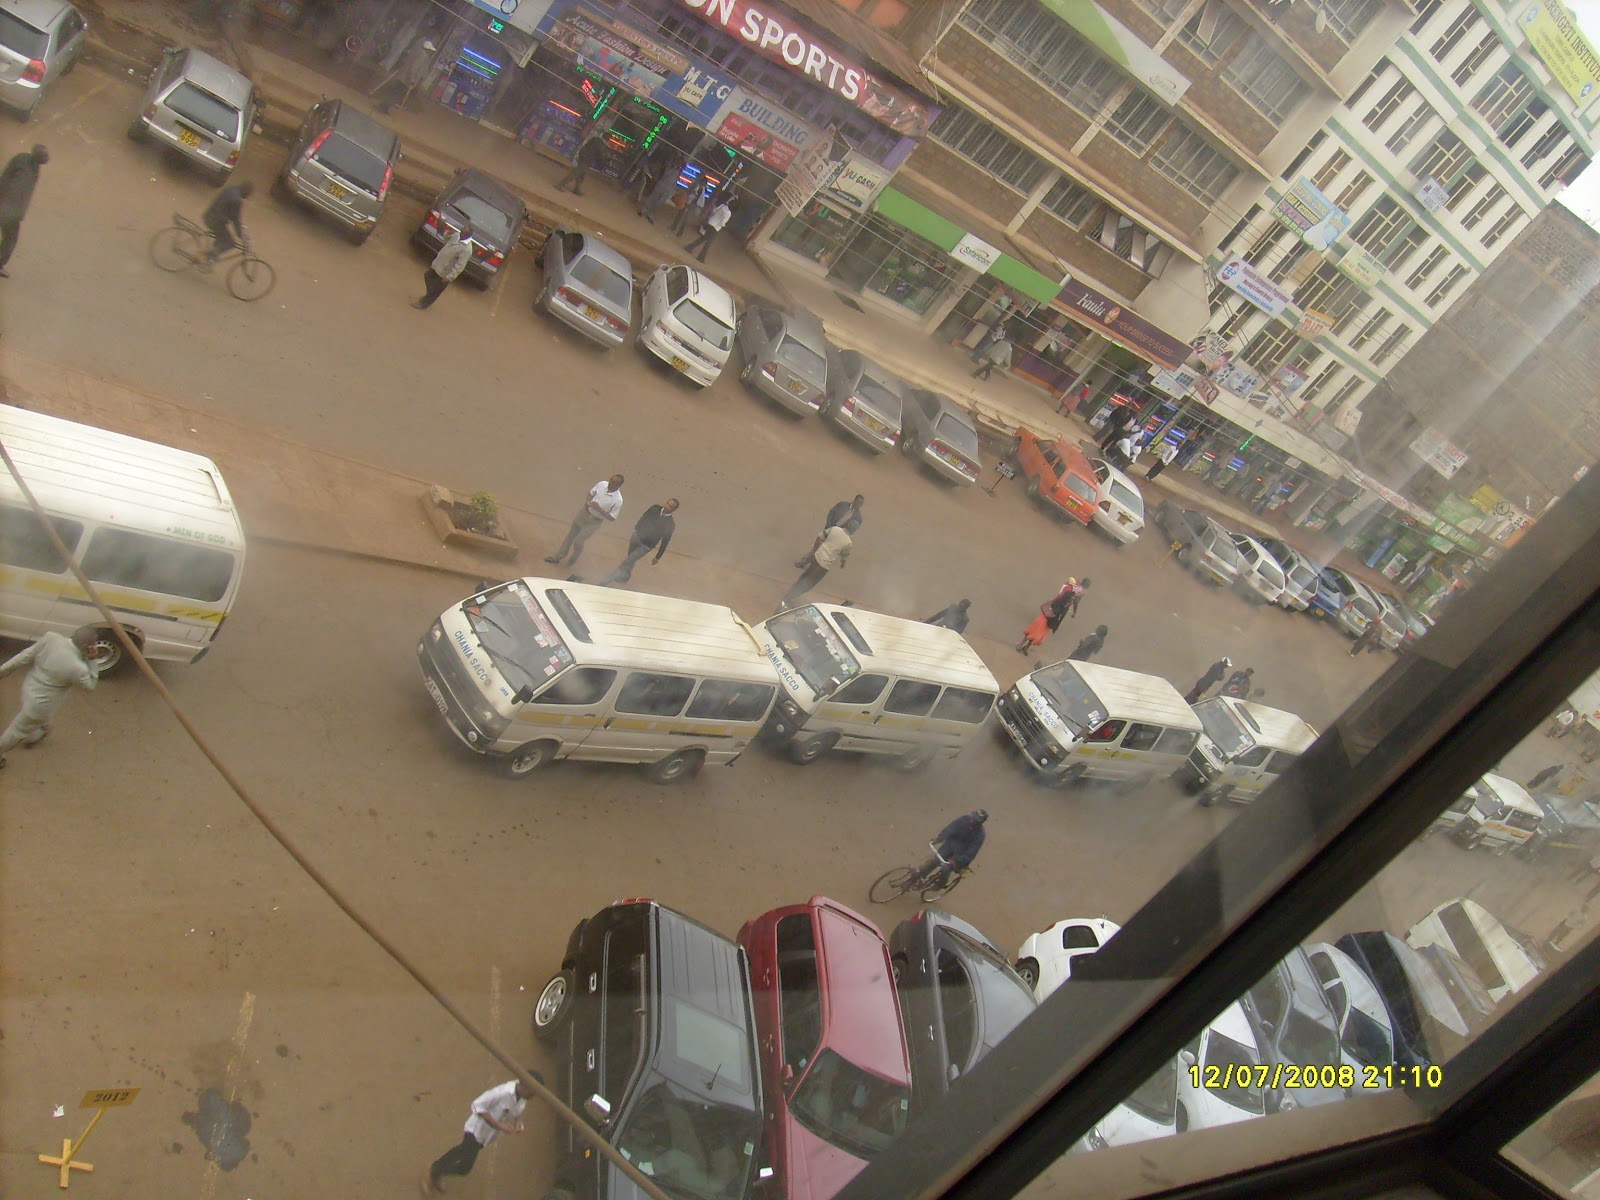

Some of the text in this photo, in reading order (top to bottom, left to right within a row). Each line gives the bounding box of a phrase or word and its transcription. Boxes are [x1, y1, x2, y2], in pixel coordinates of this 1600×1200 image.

[565, 12, 597, 35] Acute
[597, 29, 635, 57] Fashion
[686, 0, 861, 101] N SPORTS
[738, 97, 808, 144] BUILDING
[963, 245, 992, 266] Safaricom
[1076, 292, 1107, 316] Faulu
[1151, 341, 1173, 357] SUCCESS
[1301, 318, 1323, 335] TO LET
[174, 526, 226, 544] MEN OF GOD
[454, 629, 492, 687] CHANIA SACCO
[763, 643, 799, 690] CHANIA SACCO
[1028, 691, 1057, 729] CHANIA SACCO
[93, 1091, 129, 1103] 2012
